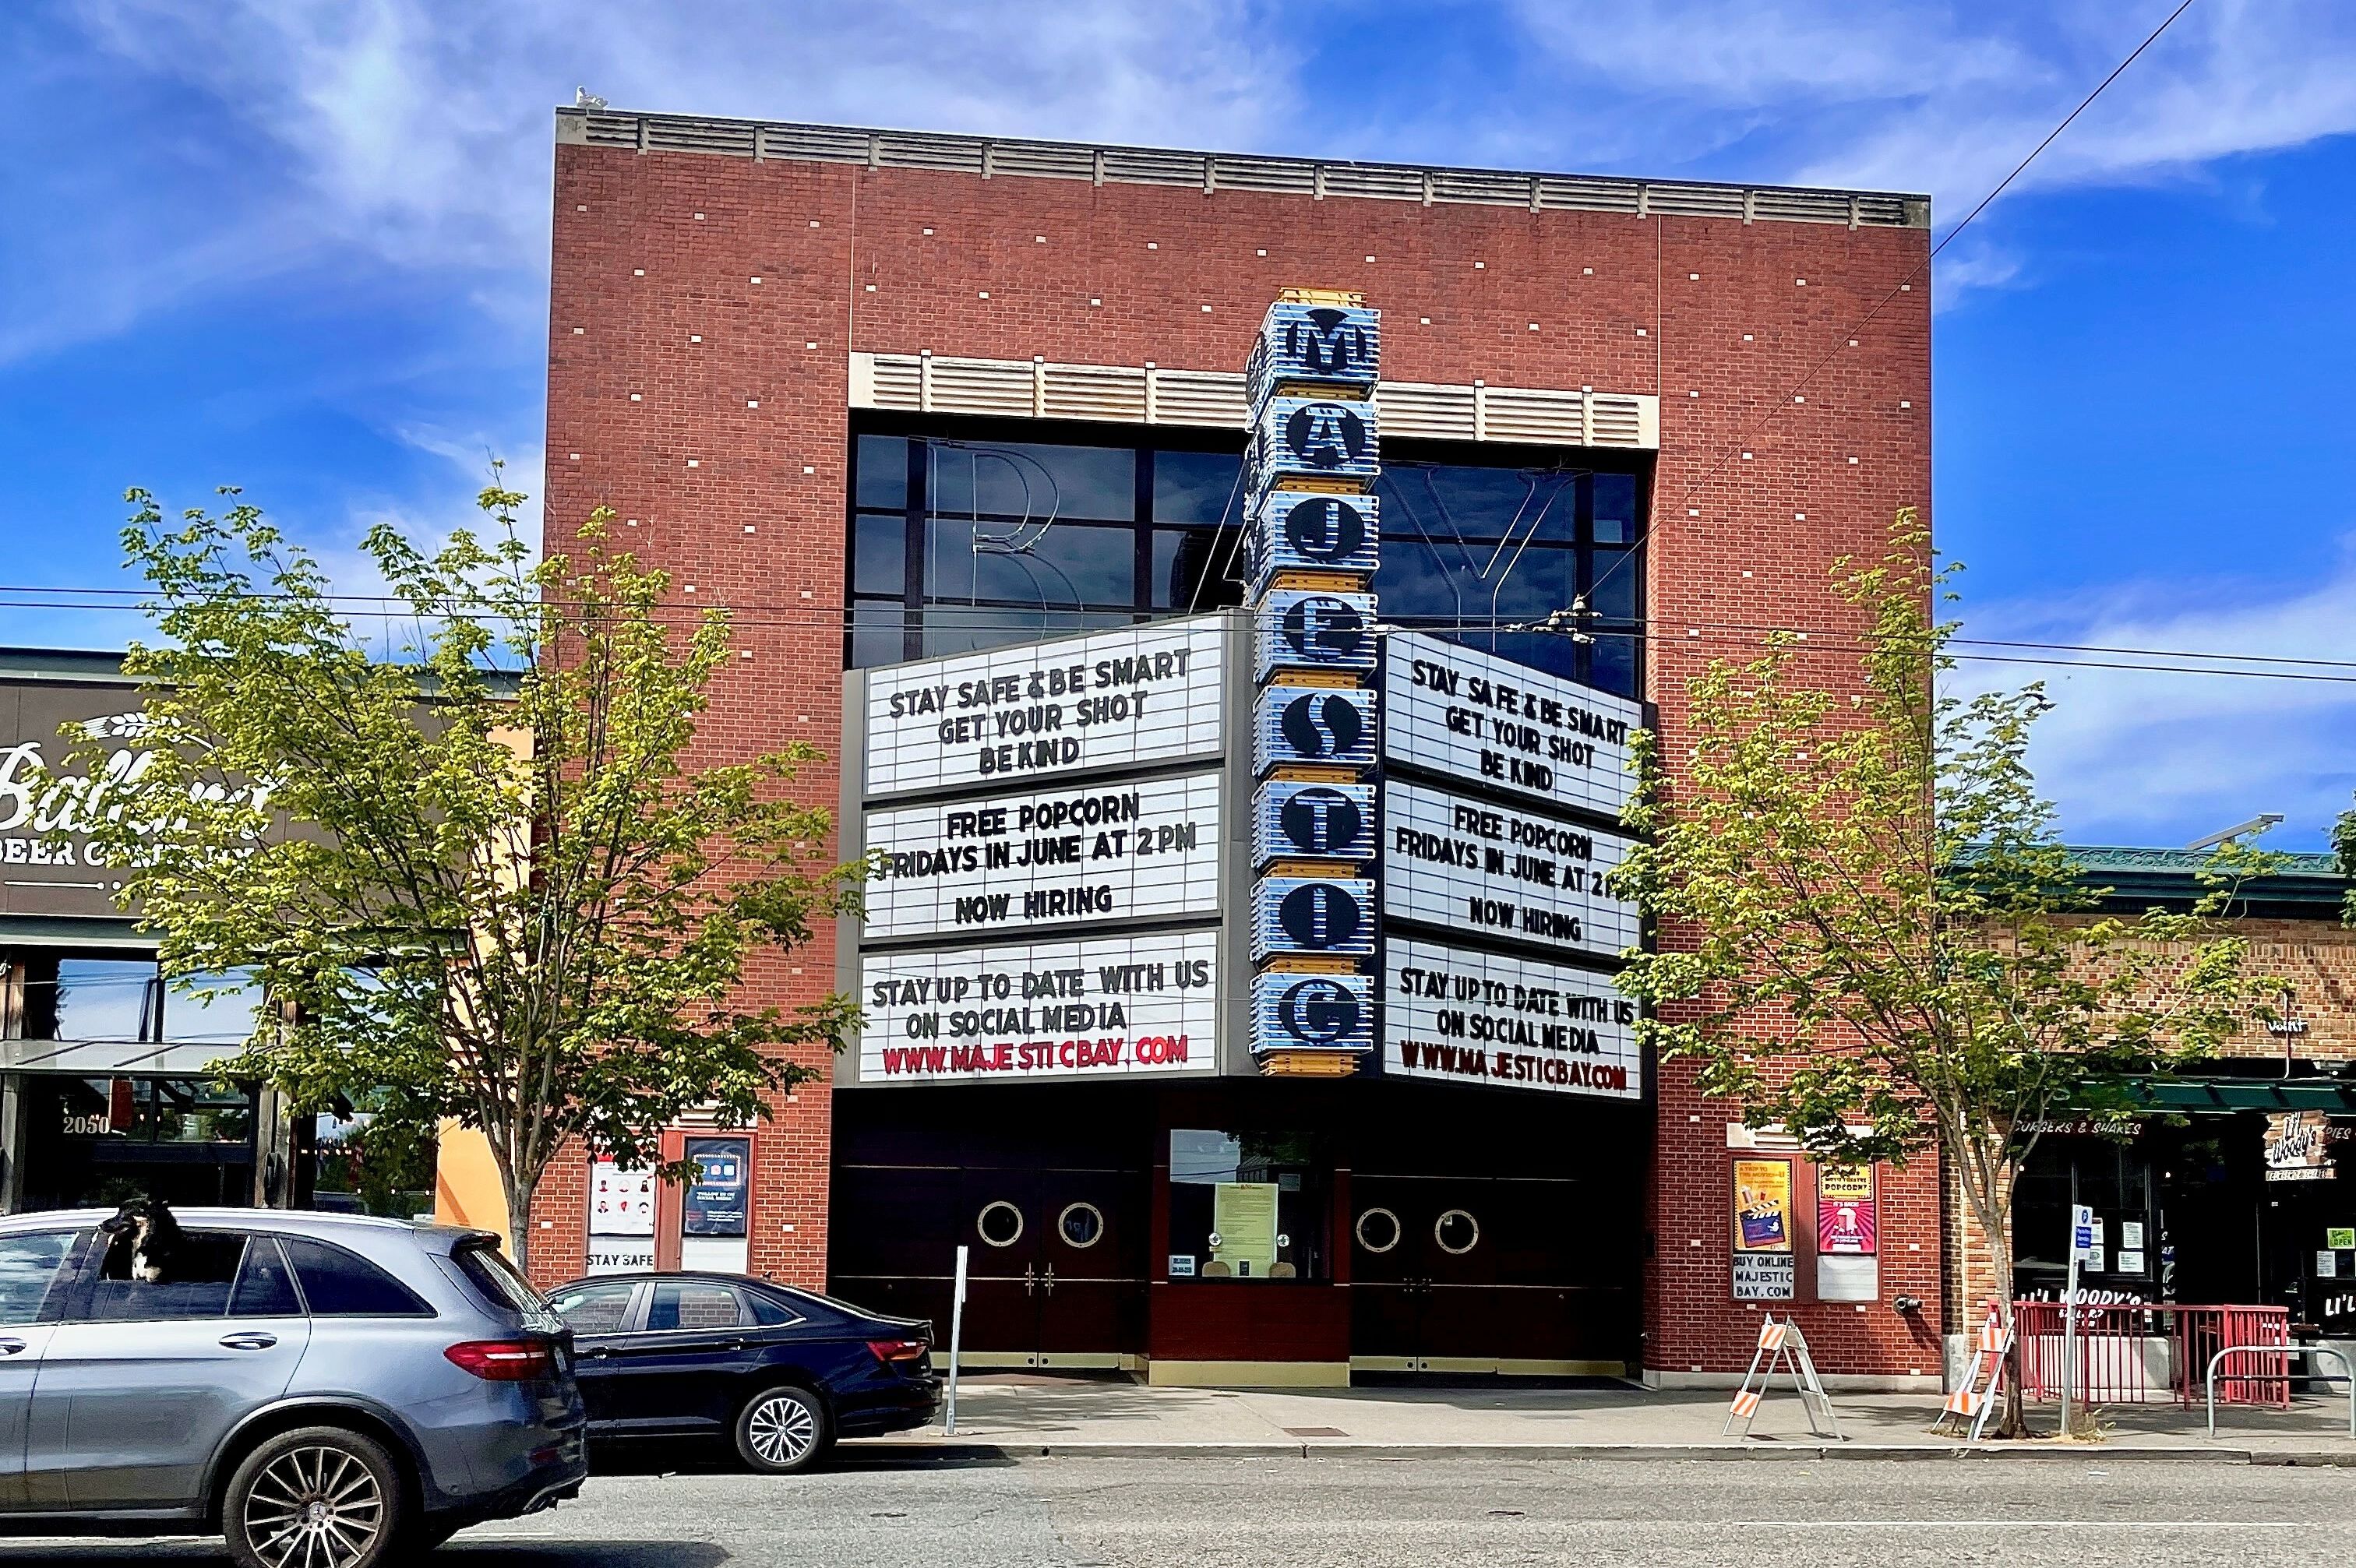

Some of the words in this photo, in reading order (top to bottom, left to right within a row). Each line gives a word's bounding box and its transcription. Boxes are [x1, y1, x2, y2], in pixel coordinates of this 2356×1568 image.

[889, 684, 949, 718] STAY
[957, 674, 1021, 709] SAFE
[1027, 671, 1045, 699] &
[1049, 664, 1085, 696] BE
[1095, 648, 1191, 689] SMART
[1412, 658, 1459, 696] STAY
[1468, 676, 1518, 716] SAFE
[1523, 692, 1537, 721] &
[1540, 697, 1563, 728] BE
[1567, 706, 1628, 746] SMART
[938, 714, 986, 745] GET
[994, 703, 1063, 738] YOUR
[1077, 690, 1148, 727] SHOT
[1445, 705, 1485, 739] GET
[1491, 717, 1541, 756] YOUR
[1548, 734, 1596, 770] SHOT
[979, 745, 1013, 774] BE
[1480, 748, 1505, 780] BE
[1510, 756, 1554, 791] KIND
[947, 807, 1007, 840] FREE
[1018, 792, 1140, 833] POPCORN
[1455, 804, 1504, 841] FREE
[1510, 816, 1592, 862] POPCORN
[0, 837, 76, 866] EER
[880, 844, 978, 880] FRIDAYS
[986, 840, 1010, 869] IN
[1016, 835, 1081, 867] JUNE
[1092, 830, 1128, 861] AT
[1136, 827, 1153, 855] 2
[1158, 822, 1197, 854] PM
[1396, 826, 1479, 870] FRIDAYS
[1485, 847, 1505, 876] IN
[1510, 853, 1557, 888] JUNE
[1561, 864, 1585, 893] AT
[955, 893, 1010, 925] NOW
[1023, 885, 1113, 920] HIRING
[1469, 896, 1515, 929] NOW
[1522, 906, 1582, 941] HIRING
[872, 977, 931, 1008] STAY
[936, 976, 969, 1004] UP
[977, 973, 1010, 1001] TO
[1021, 968, 1085, 1000] DATE
[1099, 962, 1165, 995] WITH
[1174, 960, 1209, 989] US
[1400, 967, 1449, 999] STAY
[1455, 976, 1480, 1002] UP
[1483, 980, 1508, 1007] TO
[1514, 984, 1560, 1016] DATE
[1566, 992, 1607, 1023] WITH
[1614, 1000, 1634, 1025] US
[905, 1011, 939, 1040] ON
[949, 1006, 1035, 1038] SOCIAL
[1042, 1002, 1127, 1034] MEDIA
[1437, 1009, 1465, 1038] ON
[1470, 1013, 1539, 1048] SOCIAL
[1542, 1023, 1601, 1055] MEDIA
[62, 1115, 110, 1134] 2050
[2078, 1122, 2087, 1133] &
[587, 1254, 619, 1267] STAY
[623, 1254, 654, 1267] SAFE
[1733, 1256, 1753, 1268] BUY
[1757, 1256, 1794, 1268] ONLINE
[1735, 1270, 1793, 1284] MAJESTIC
[1736, 1286, 1791, 1298] BAY.COM
